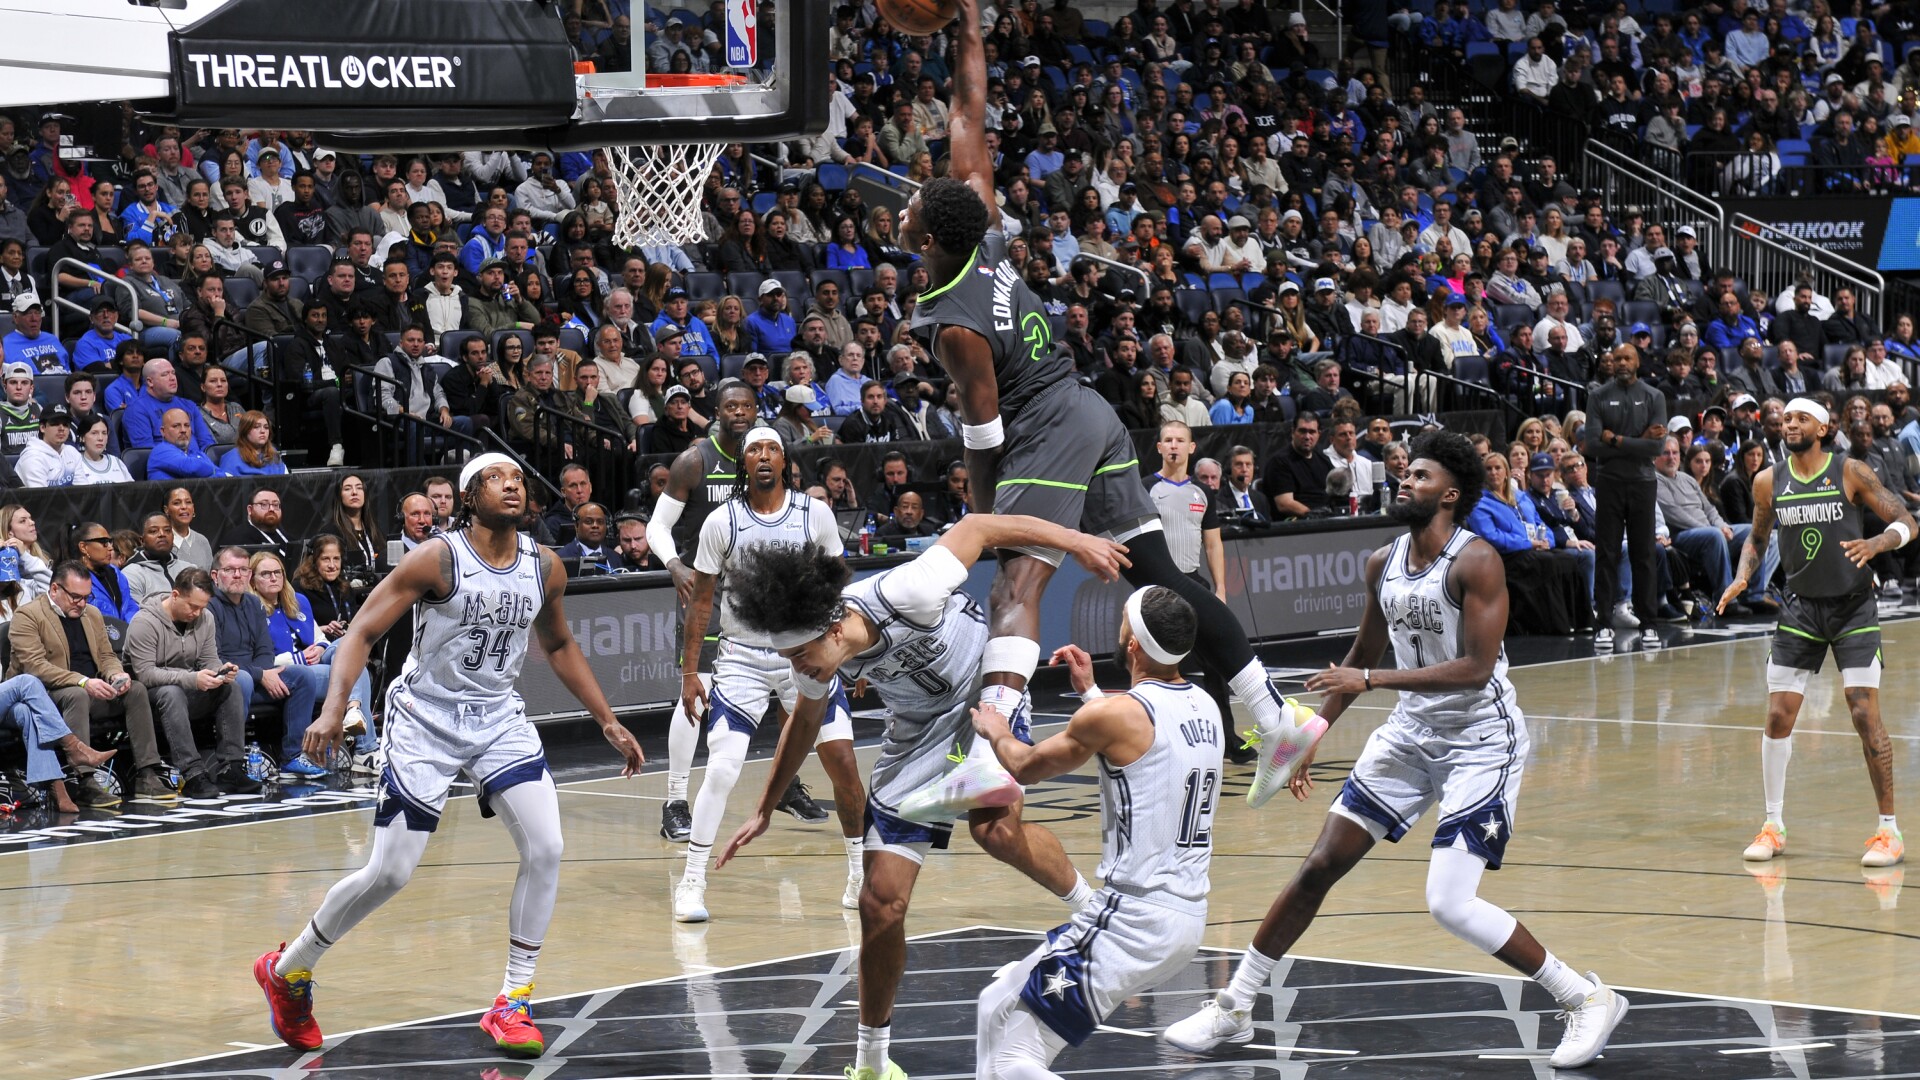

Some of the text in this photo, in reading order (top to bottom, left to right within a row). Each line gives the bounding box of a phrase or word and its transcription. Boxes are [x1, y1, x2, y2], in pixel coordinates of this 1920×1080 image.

[730, 46, 746, 62] NBA
[188, 54, 457, 88] THREATLOCKER
[1775, 501, 1844, 528] TIMBERWOLVES
[1801, 527, 1823, 561] 9
[1294, 590, 1343, 615] driving
[462, 627, 514, 672] 34
[1409, 633, 1426, 669] 1
[906, 667, 953, 698] 0
[1180, 718, 1218, 749] QUEEN
[1175, 767, 1218, 849] 12
